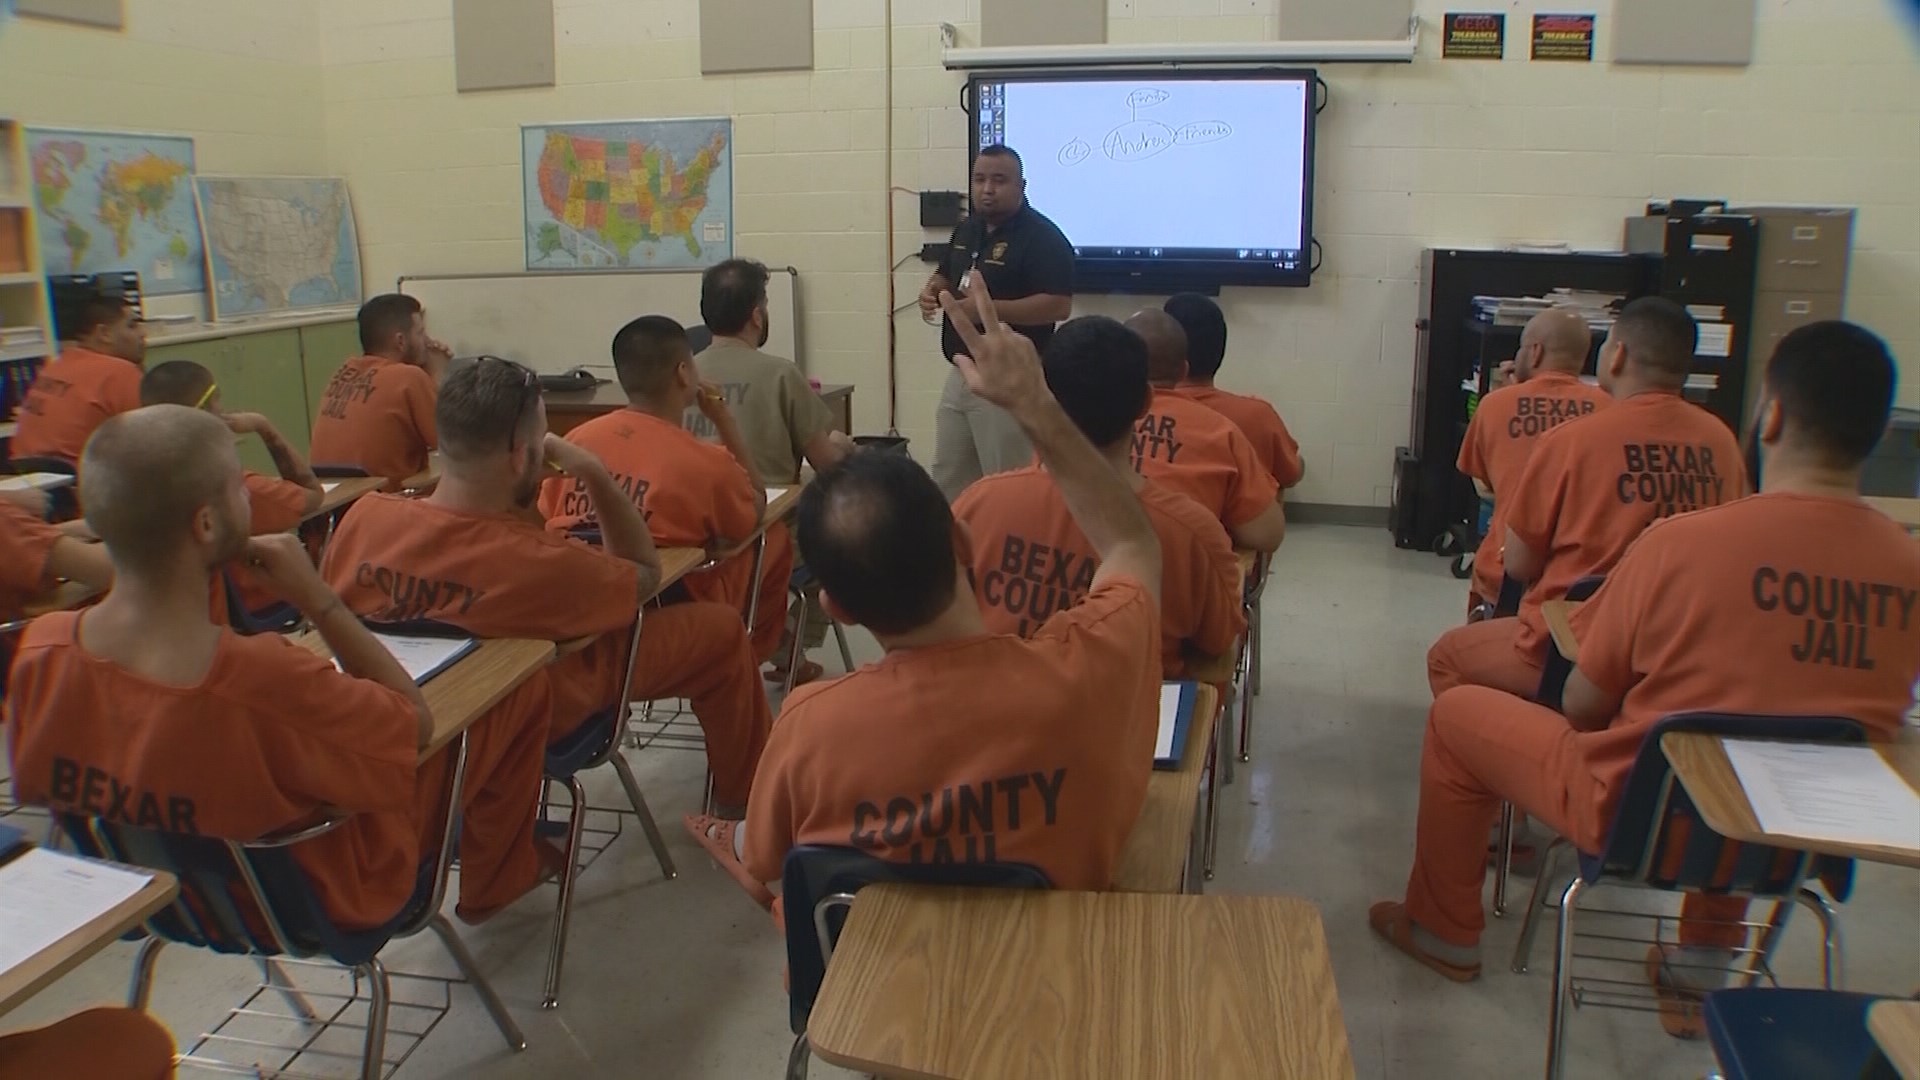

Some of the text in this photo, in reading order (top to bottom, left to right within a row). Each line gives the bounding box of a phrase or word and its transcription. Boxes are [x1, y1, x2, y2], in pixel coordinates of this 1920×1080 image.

[1517, 397, 1596, 417] BEXAR
[1624, 444, 1717, 476] BEXAR
[1617, 473, 1724, 506] COUNTY
[356, 562, 486, 616] COUNTY
[1001, 535, 1097, 595] BEXA
[1753, 566, 1918, 631] COUNTY
[1791, 619, 1876, 671] JAIL
[52, 756, 198, 834] BEXAR
[851, 768, 1067, 849] COUNTY
